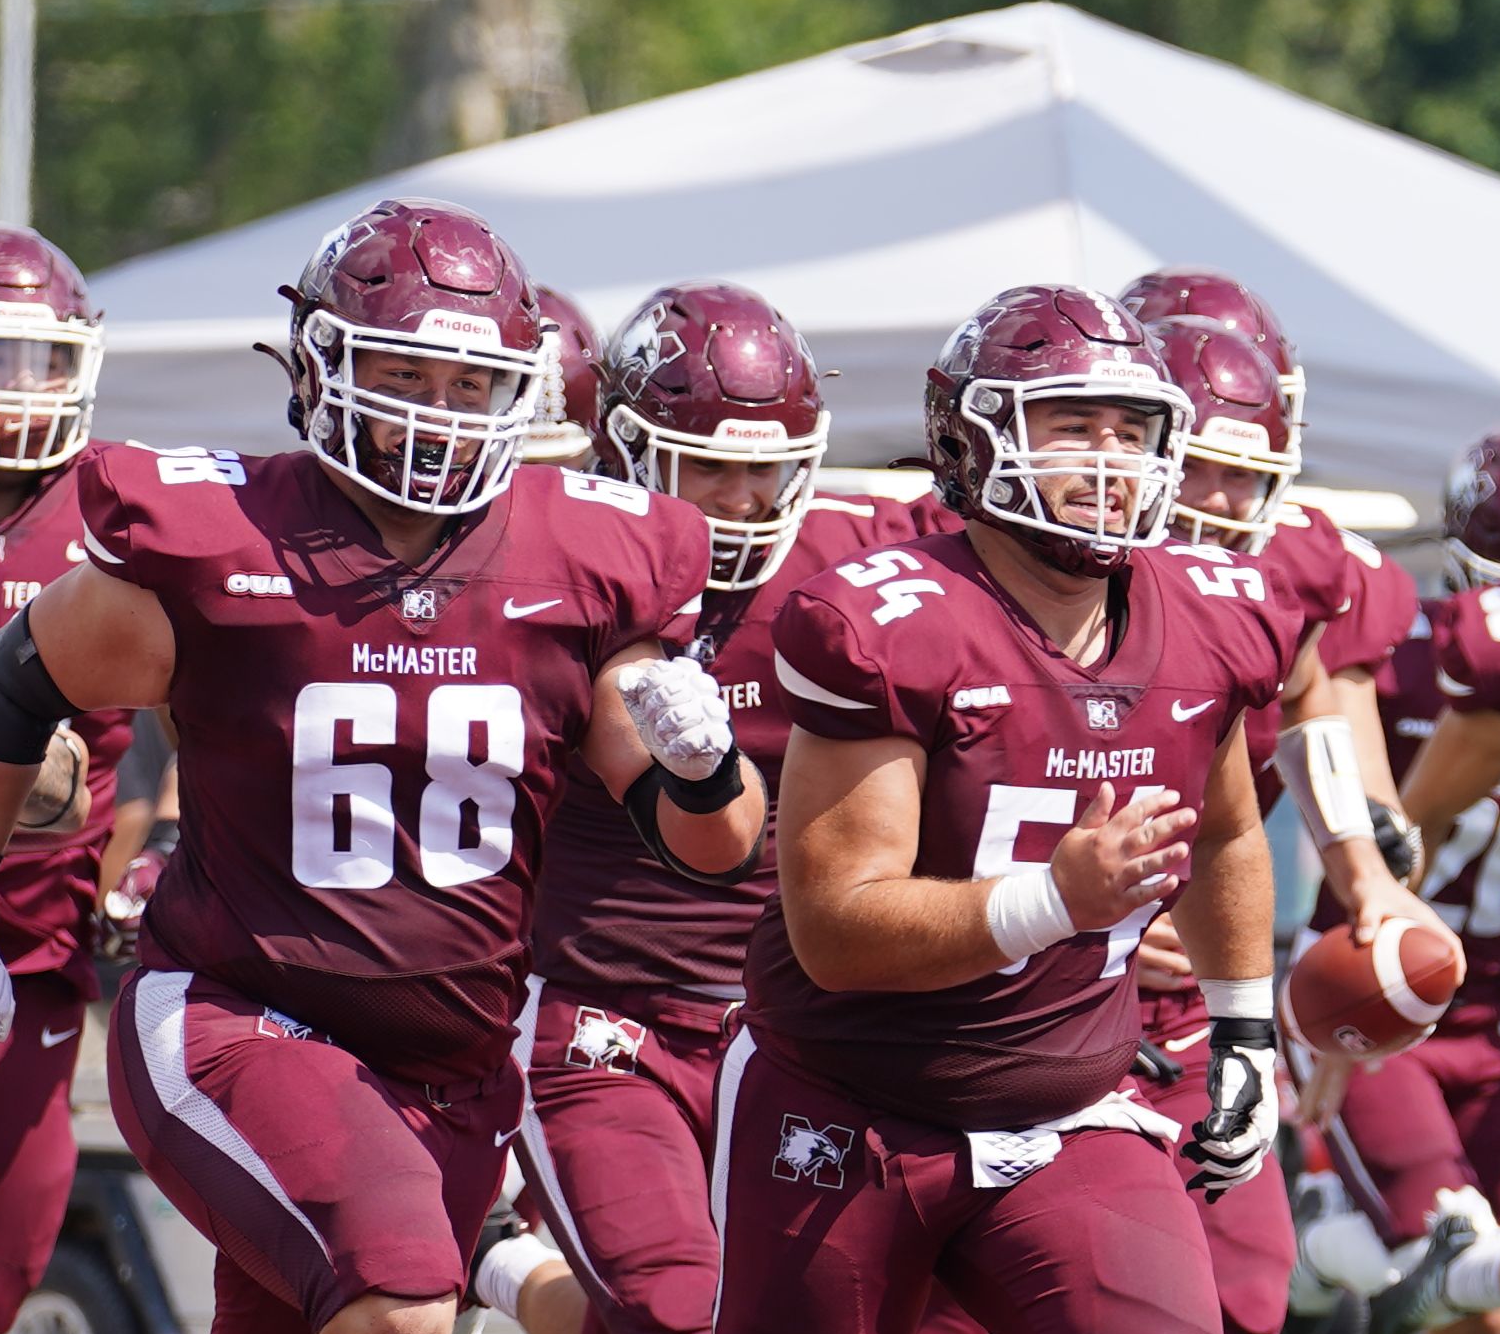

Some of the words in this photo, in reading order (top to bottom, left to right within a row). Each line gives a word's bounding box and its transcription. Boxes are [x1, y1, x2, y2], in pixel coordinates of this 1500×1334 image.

[433, 317, 493, 337] Riddell
[725, 426, 780, 441] Riddell
[226, 572, 295, 597] OUA
[835, 549, 946, 626] 54
[351, 642, 477, 676] McMASTER
[953, 684, 1012, 710] OUA
[1045, 747, 1156, 780] McMASTER
[291, 681, 526, 890] 68
